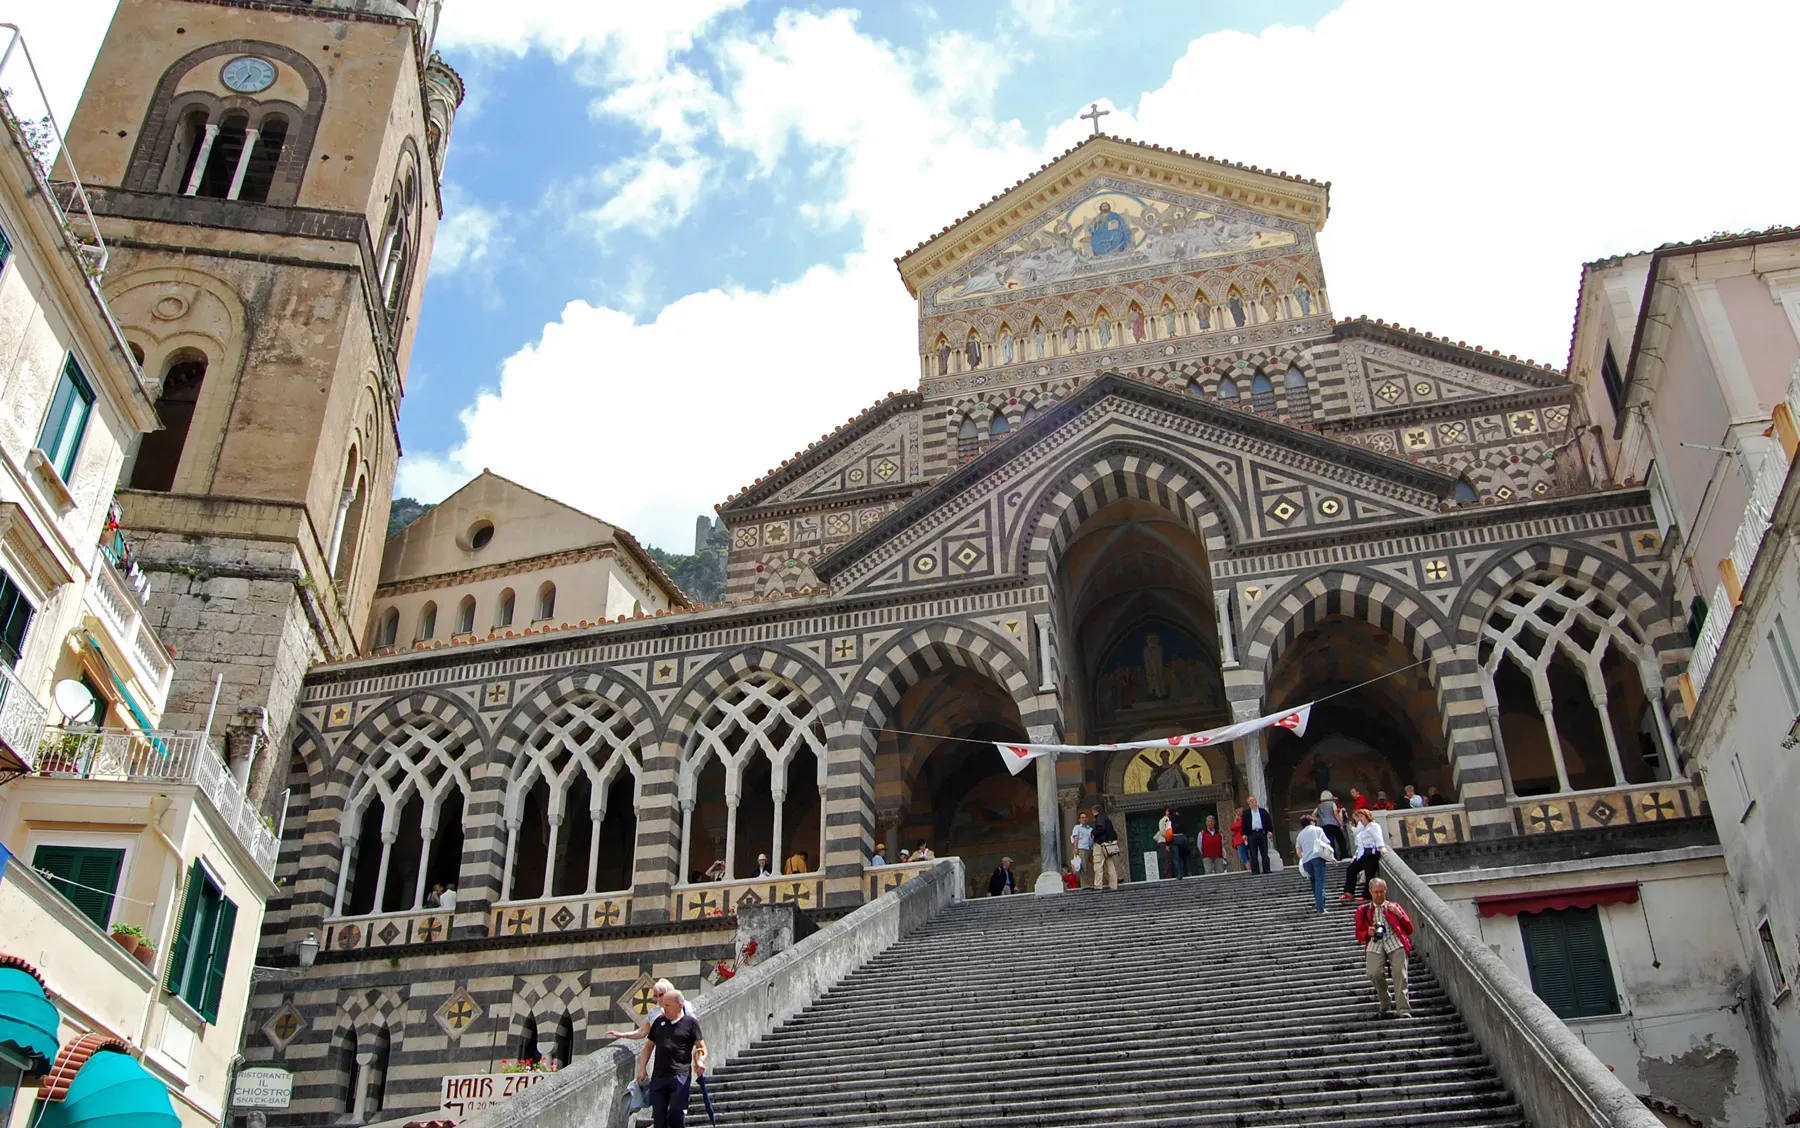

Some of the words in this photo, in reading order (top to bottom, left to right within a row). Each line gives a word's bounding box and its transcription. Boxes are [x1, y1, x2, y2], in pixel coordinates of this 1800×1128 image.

[238, 1071, 292, 1080] RISTORANTE
[235, 1088, 291, 1097] CHIOSTRO
[446, 1078, 493, 1098] HAIR
[476, 1101, 487, 1110] 20
